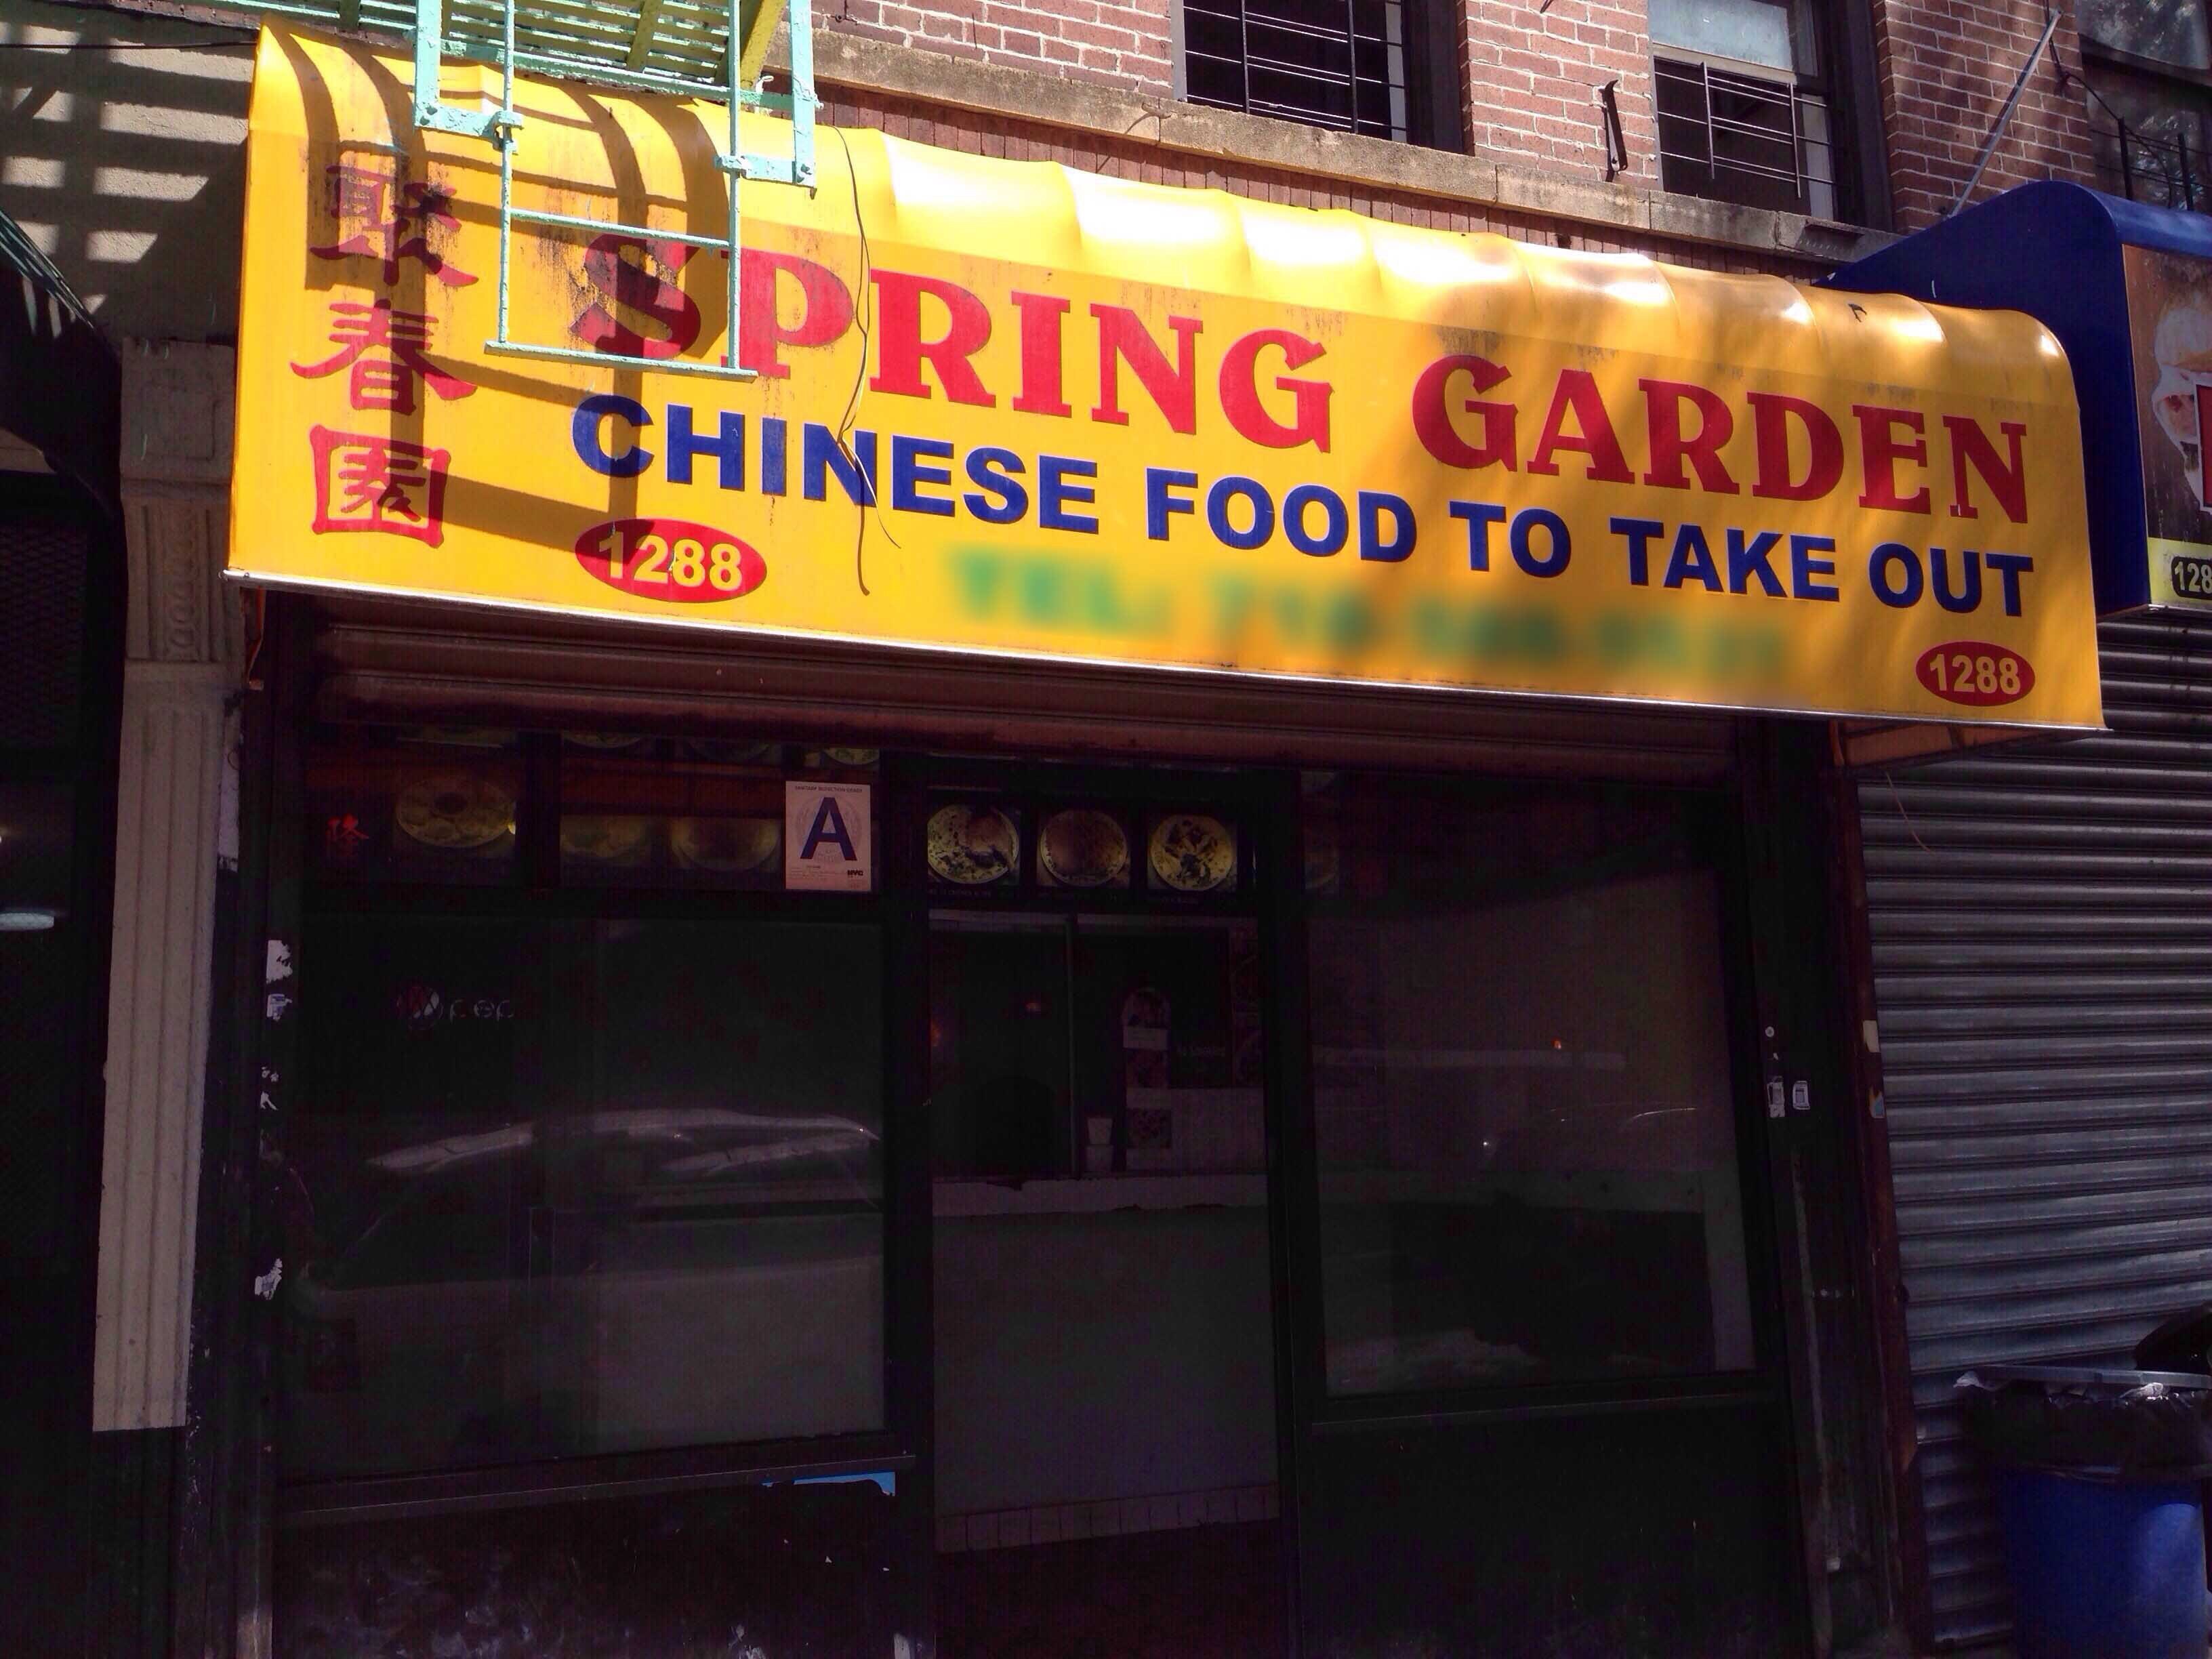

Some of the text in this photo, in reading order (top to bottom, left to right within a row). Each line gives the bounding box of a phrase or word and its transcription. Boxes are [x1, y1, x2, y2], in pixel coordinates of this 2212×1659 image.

[570, 232, 2027, 524] SPRING GARDEN
[571, 394, 2034, 617] CHINESE FOOD TO TAKE OUT
[599, 531, 743, 592] 1288
[1930, 653, 2022, 695] 1288
[800, 797, 857, 861] A
